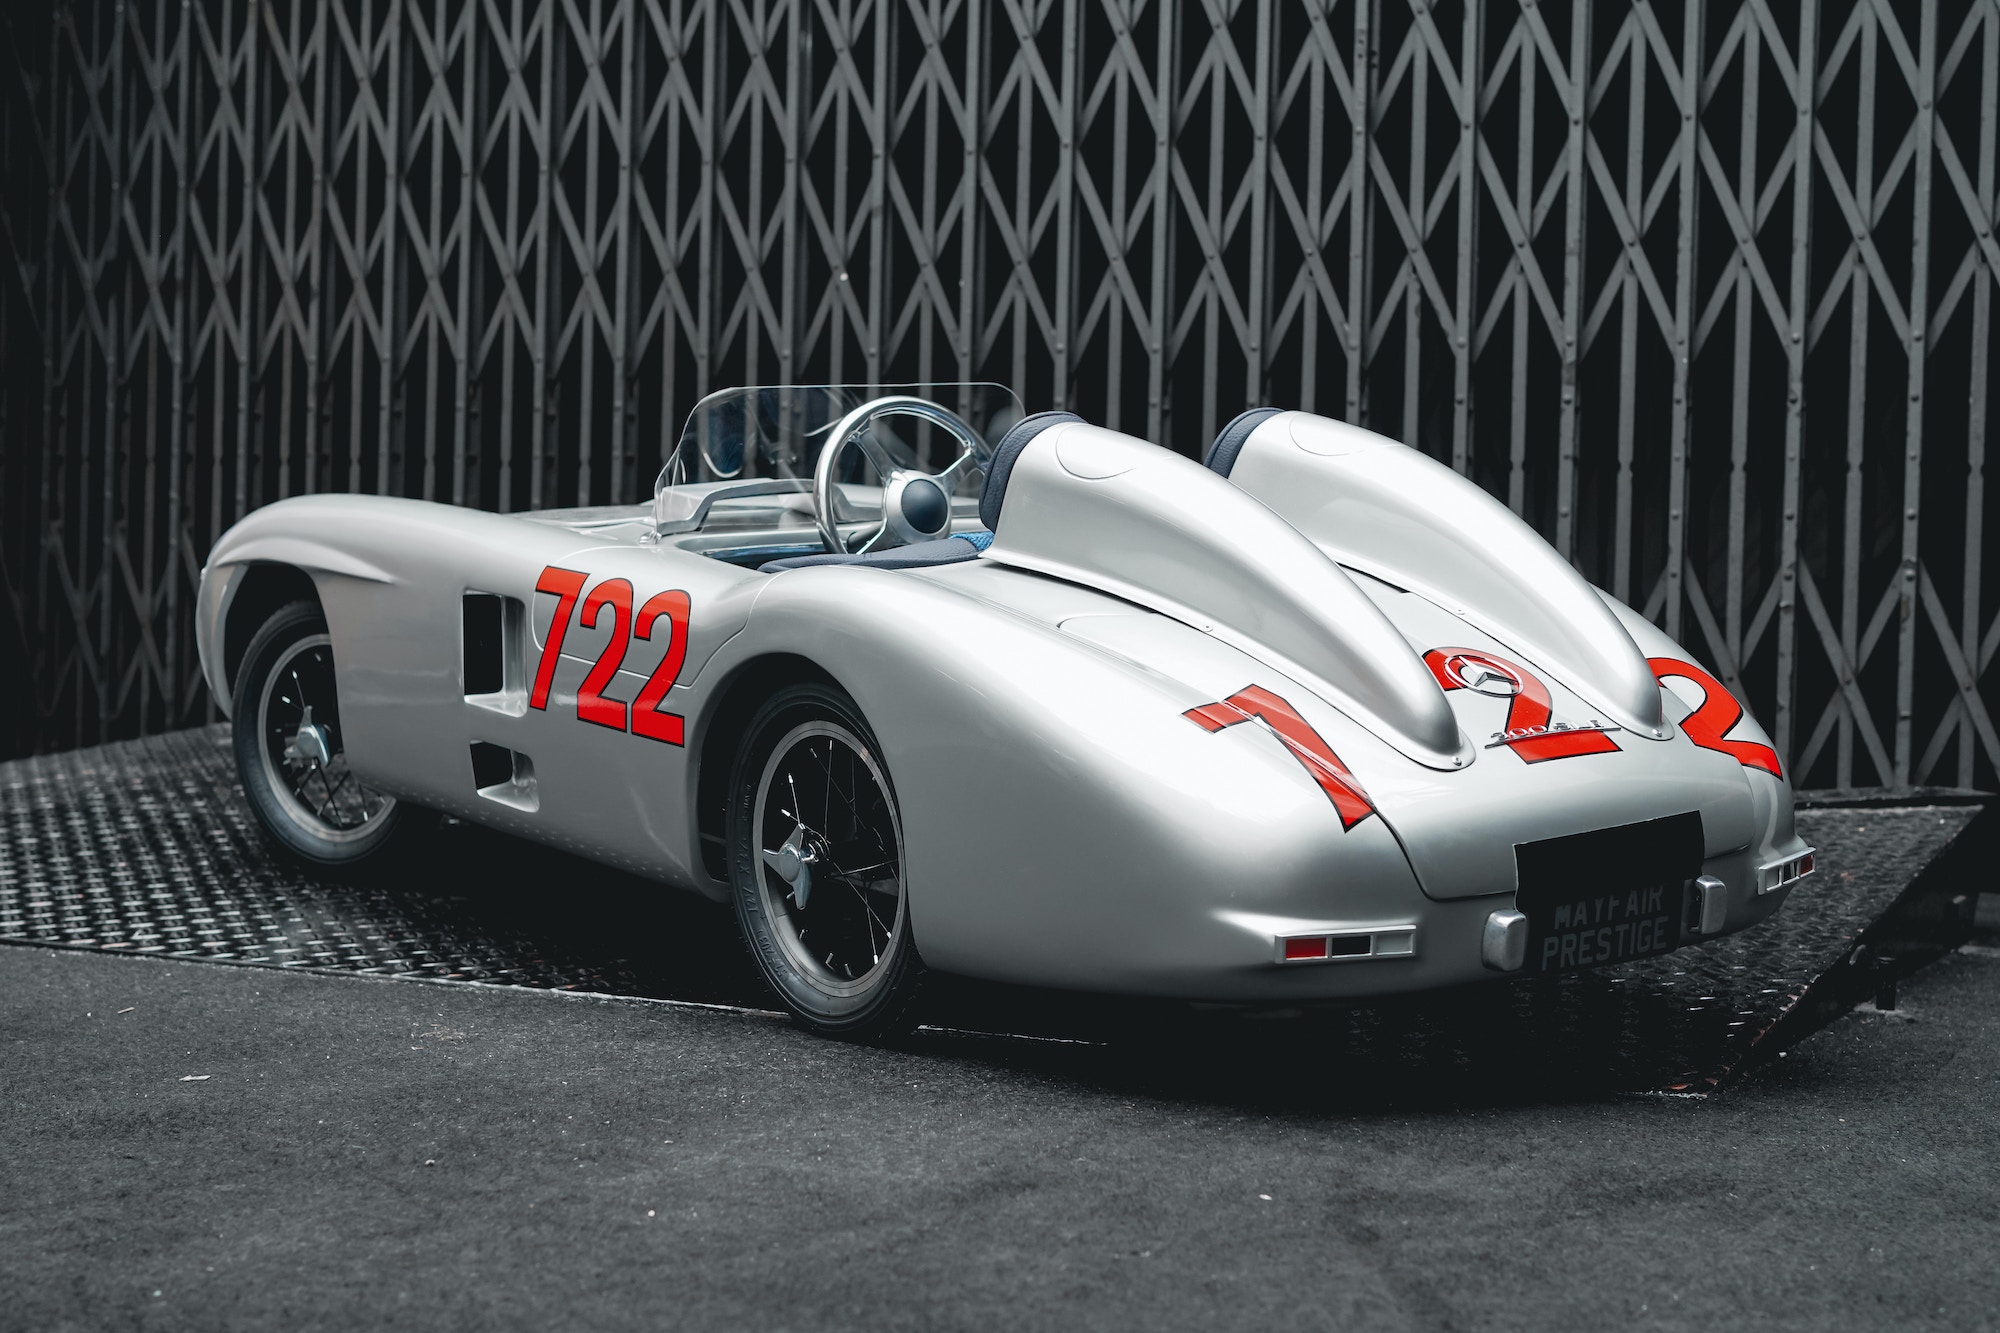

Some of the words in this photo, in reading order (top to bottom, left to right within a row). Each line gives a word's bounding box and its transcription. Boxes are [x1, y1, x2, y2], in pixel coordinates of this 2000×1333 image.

[529, 565, 692, 748] 722
[1553, 884, 1665, 930] MAYFAIR
[1541, 915, 1670, 972] PRESTIGE
